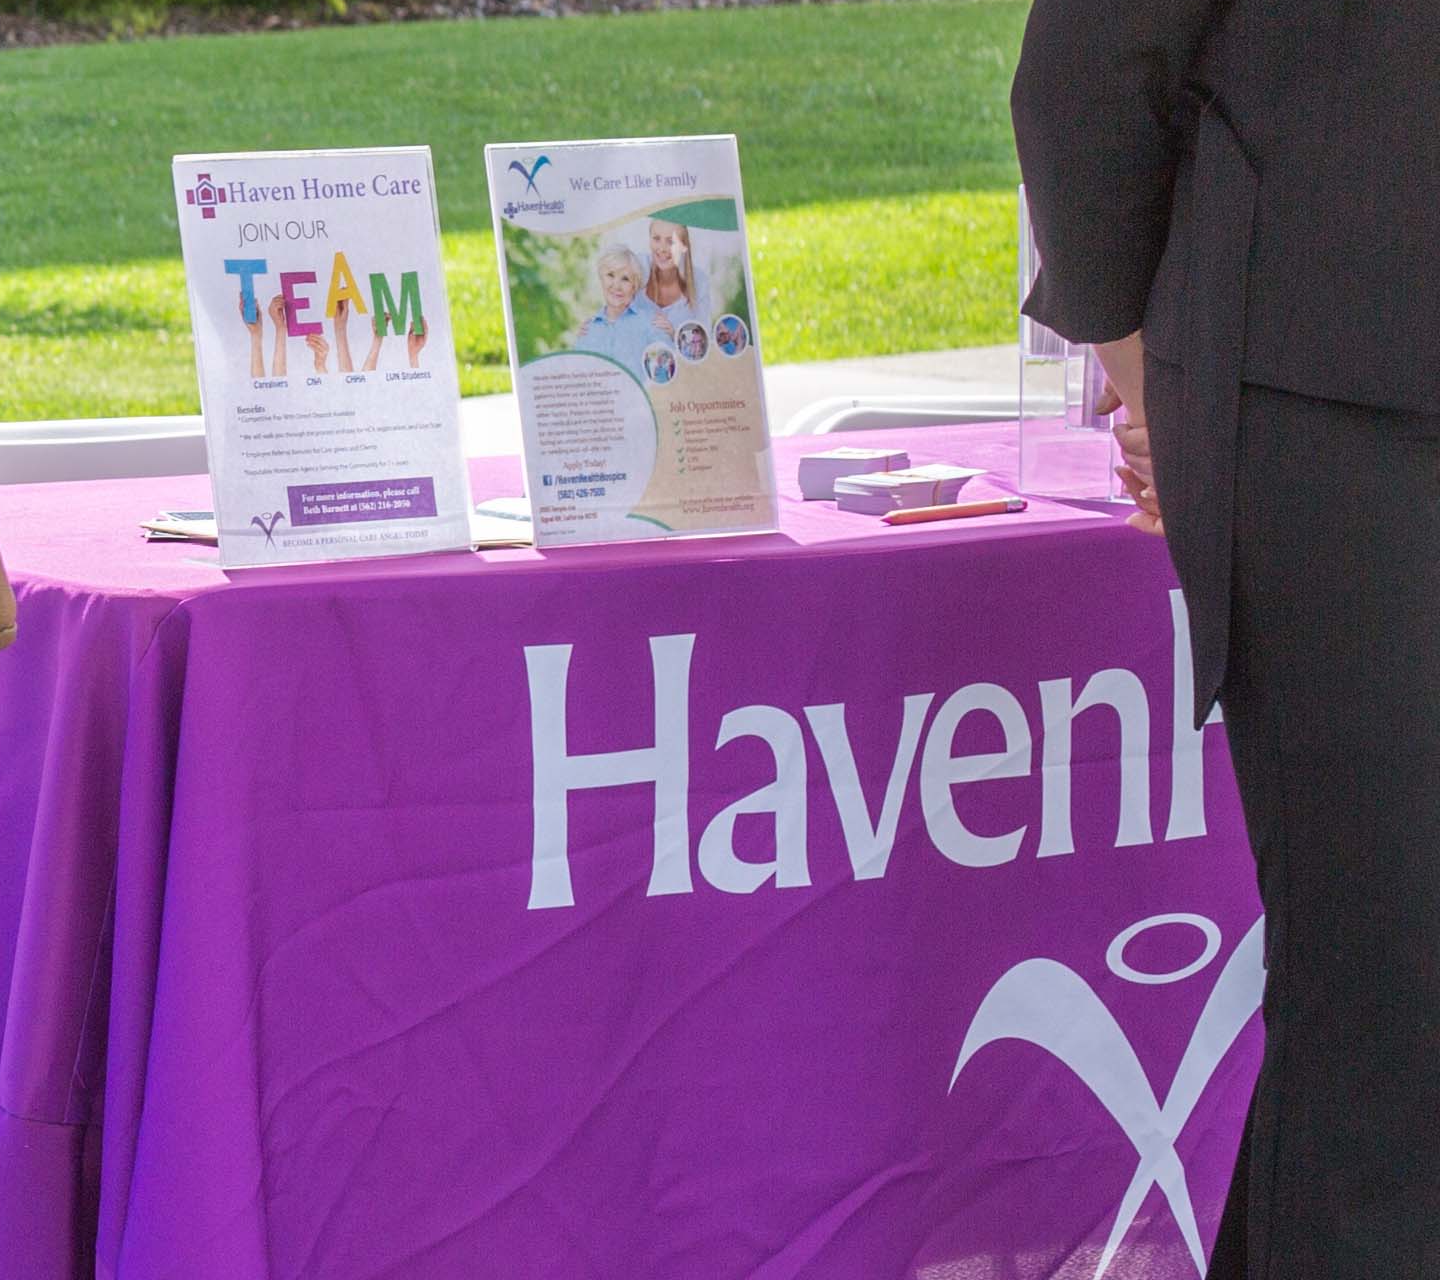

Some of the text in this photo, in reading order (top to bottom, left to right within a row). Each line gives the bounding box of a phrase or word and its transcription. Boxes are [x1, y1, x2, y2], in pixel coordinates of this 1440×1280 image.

[228, 174, 421, 203] Haven Home Care
[594, 176, 621, 190] Care
[625, 174, 652, 189] Like
[656, 171, 697, 191] Family
[238, 220, 328, 248] JOIN OUR
[223, 251, 425, 338] TEAM
